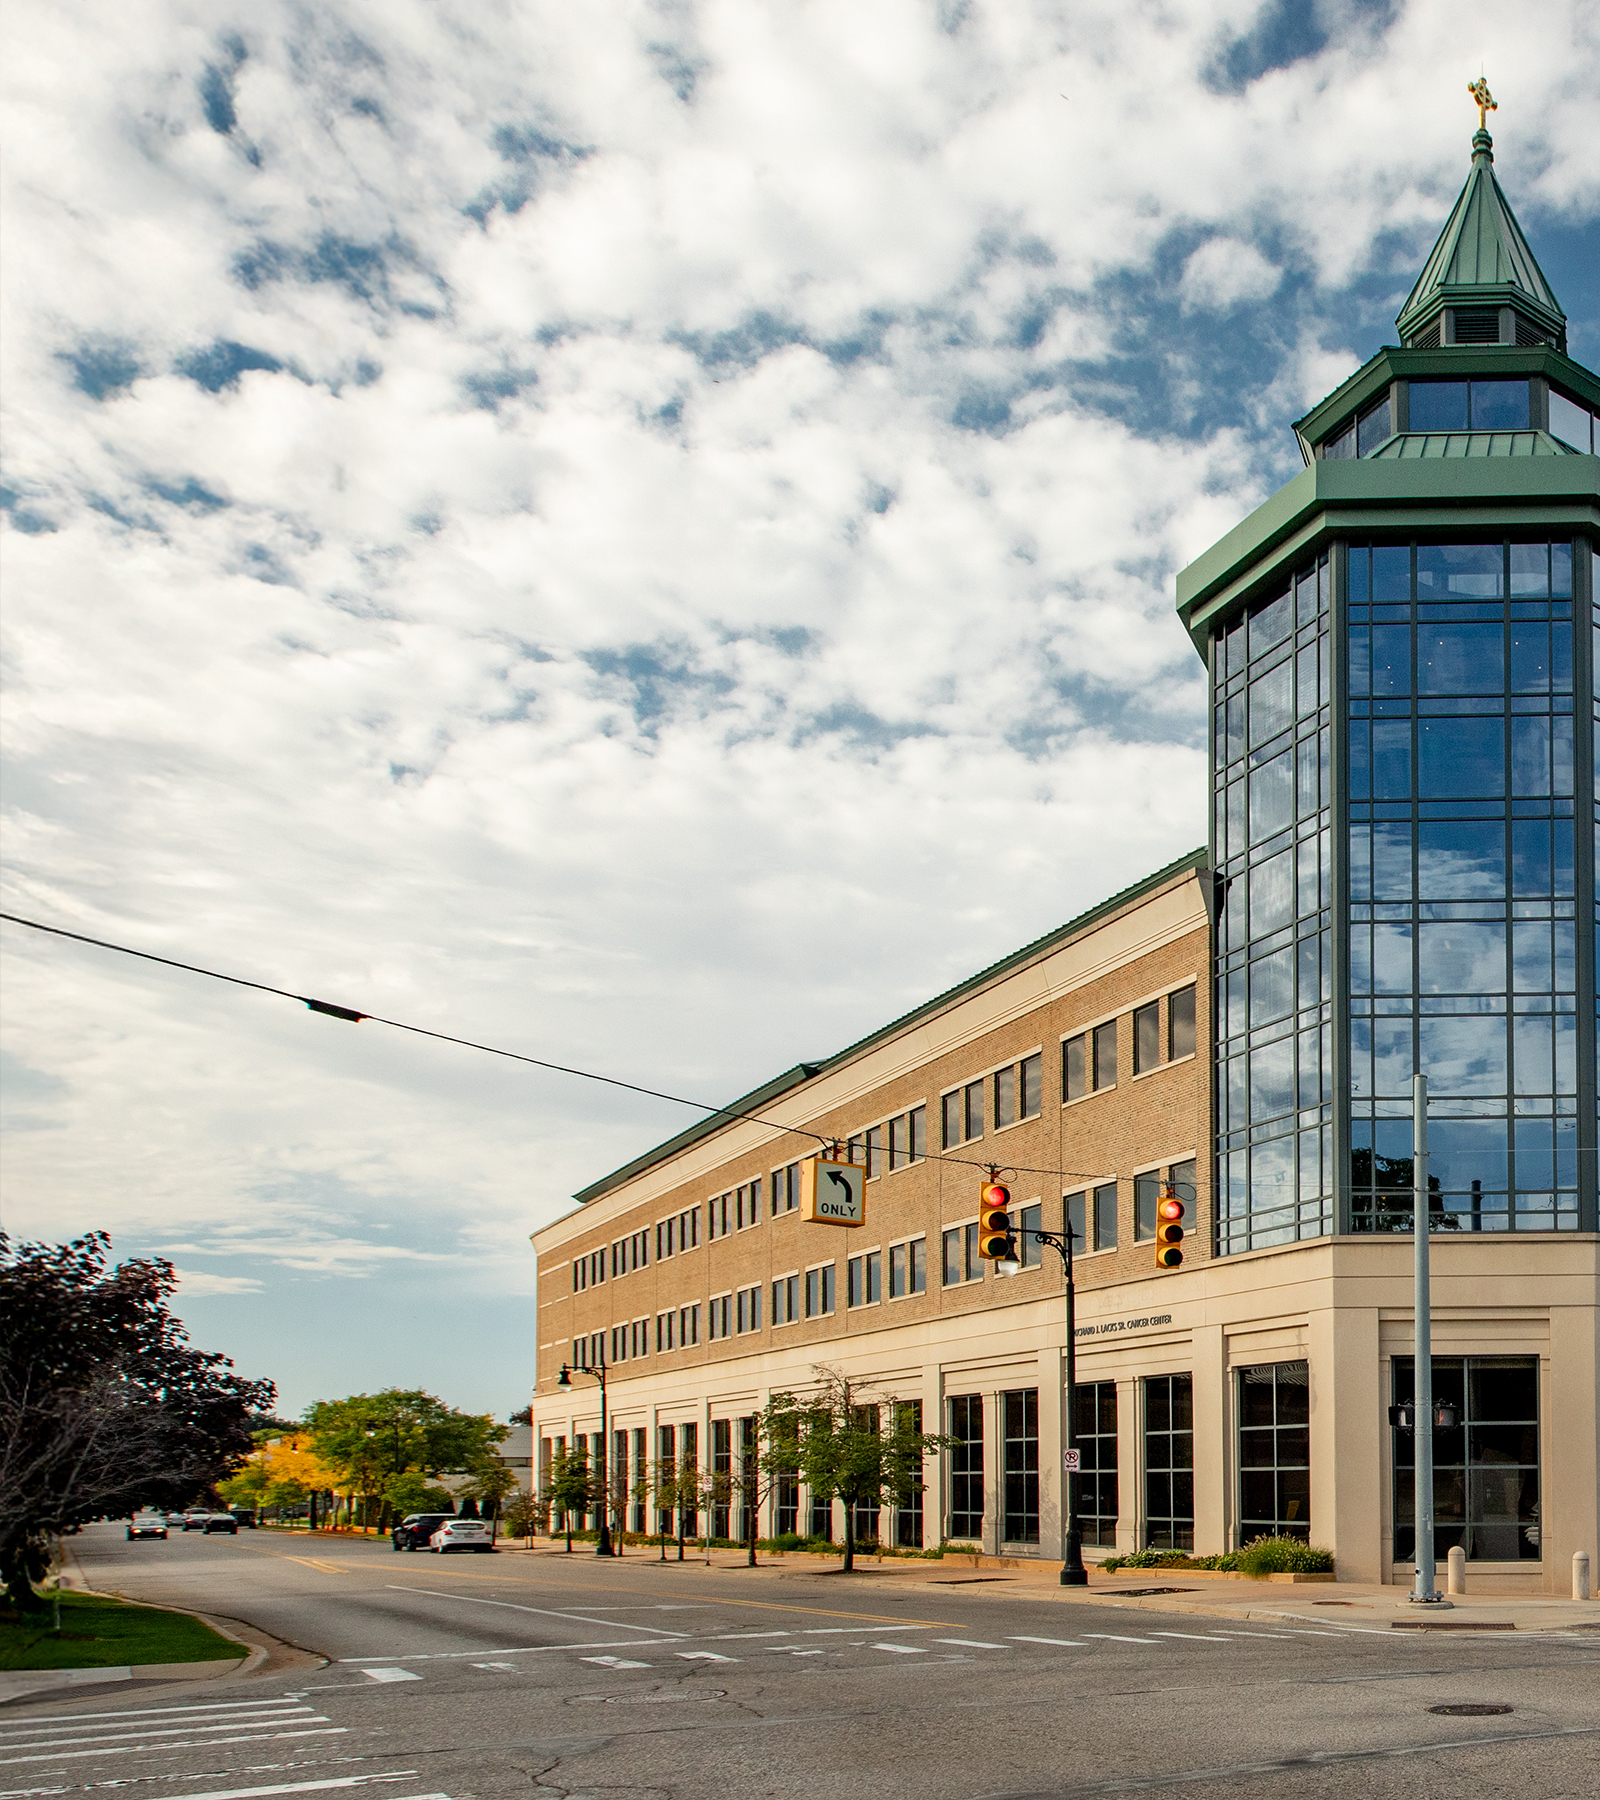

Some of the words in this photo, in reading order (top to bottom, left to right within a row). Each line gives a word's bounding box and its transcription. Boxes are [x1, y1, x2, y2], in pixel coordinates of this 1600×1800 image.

[821, 1203, 857, 1217] ONLY
[1100, 1323, 1117, 1333] LACKS
[1117, 1321, 1126, 1331] SR.
[1126, 1317, 1149, 1329] CANCER
[1149, 1314, 1172, 1326] CENTER
